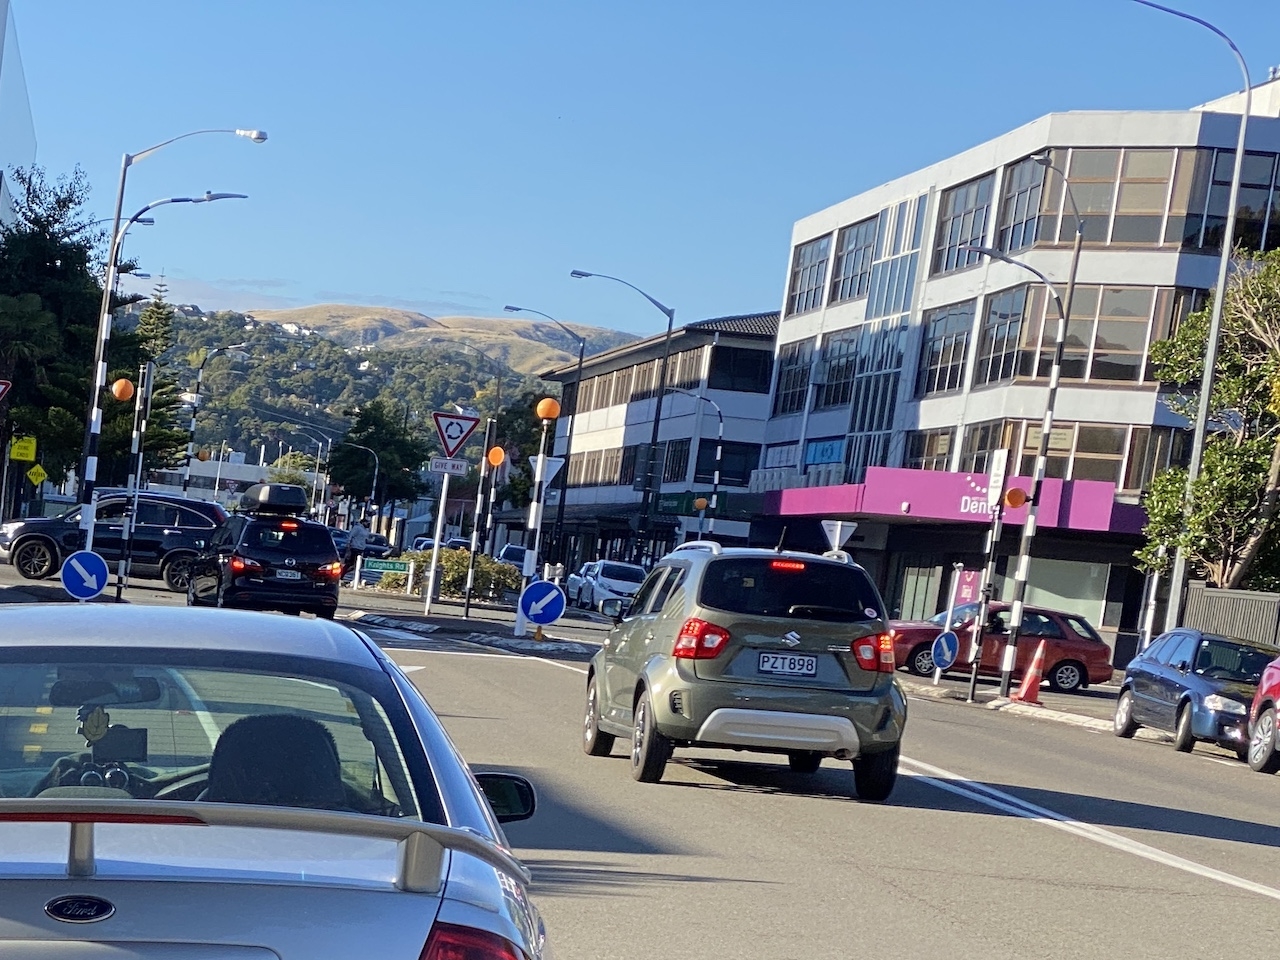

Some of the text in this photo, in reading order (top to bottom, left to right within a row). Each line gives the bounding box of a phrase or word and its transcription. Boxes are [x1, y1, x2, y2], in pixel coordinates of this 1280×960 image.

[434, 461, 464, 471] GIVE WAY
[368, 561, 405, 570] Knights Rd
[761, 655, 815, 672] PZT898
[62, 901, 98, 916] Ford
